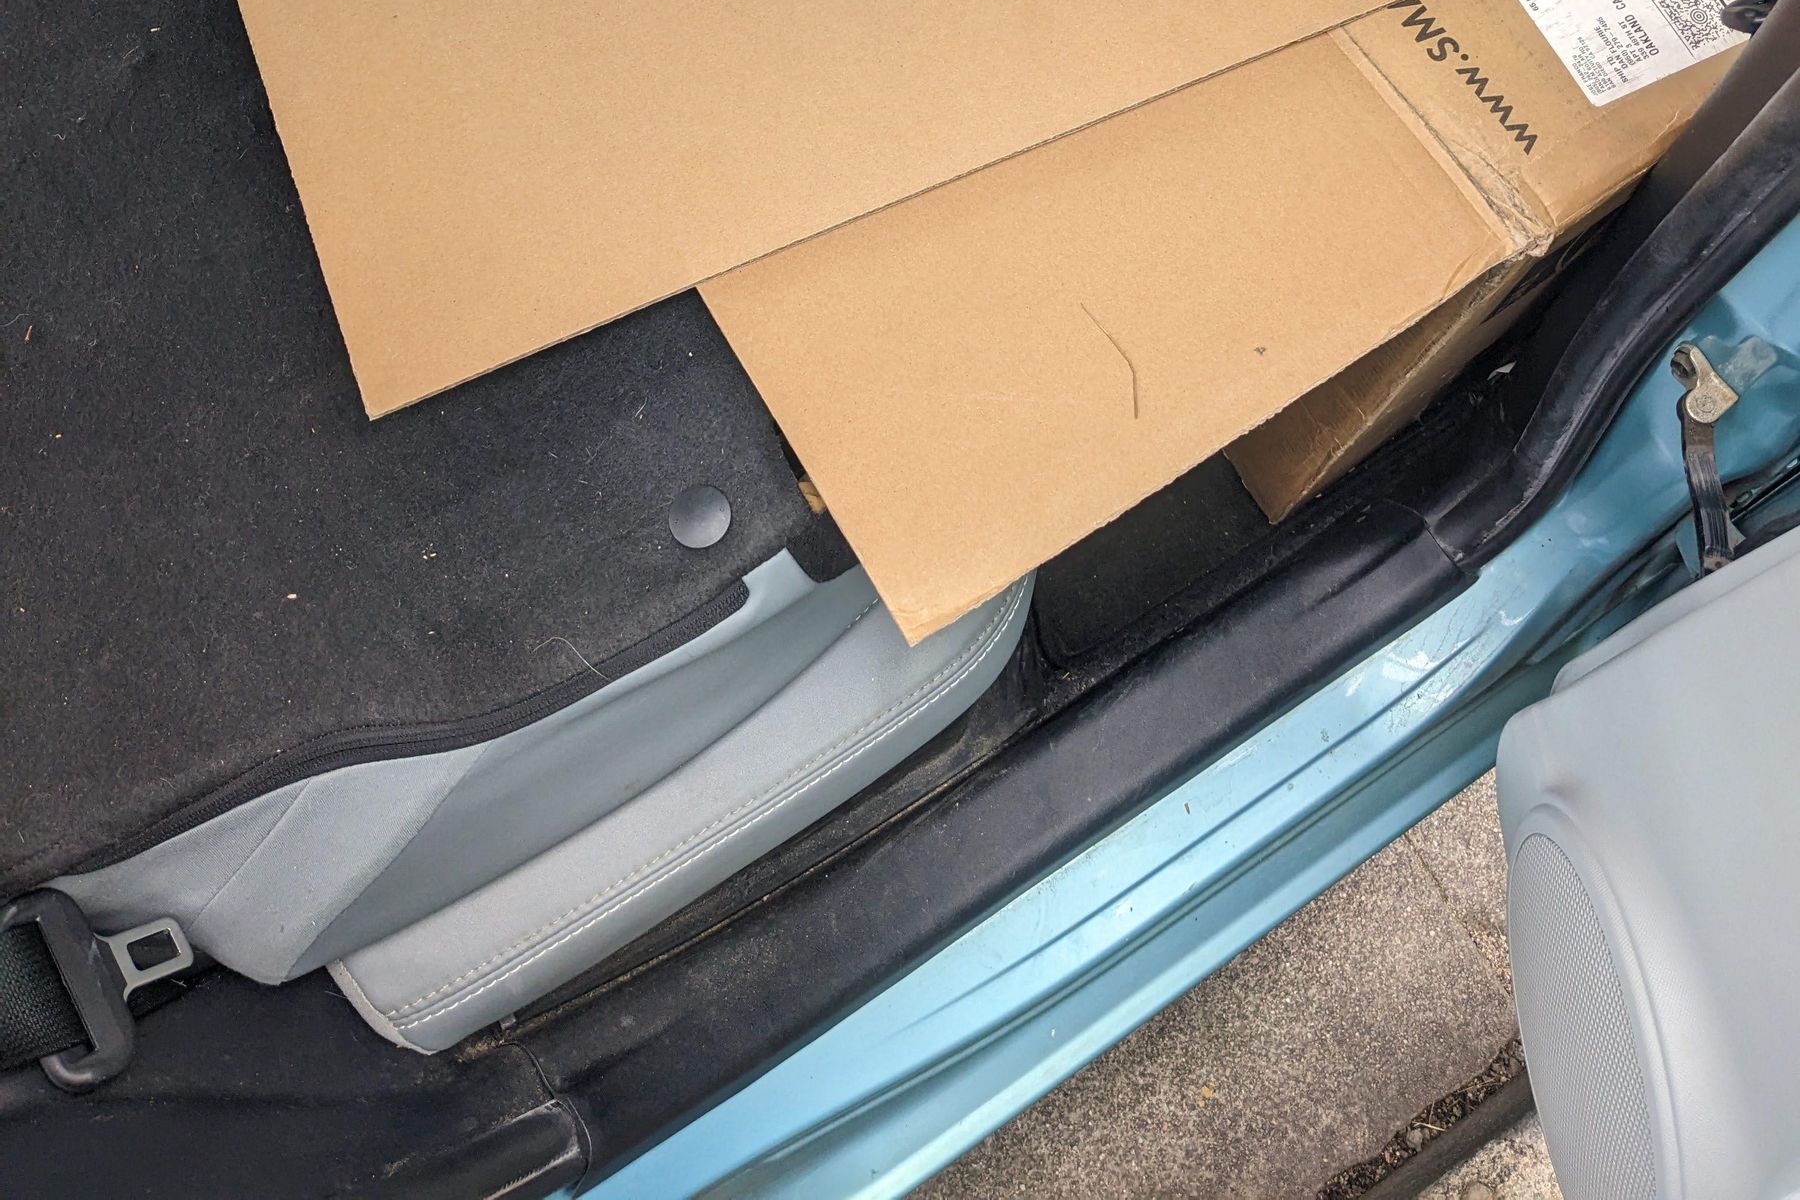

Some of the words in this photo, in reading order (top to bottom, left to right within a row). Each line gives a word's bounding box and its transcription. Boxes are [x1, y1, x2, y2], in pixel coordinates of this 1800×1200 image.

[1617, 20, 1628, 29] ST
[1625, 13, 1659, 56] OAKLAND
[1614, 54, 1628, 68] DAN
[1629, 48, 1643, 62] APT
[1612, 66, 1629, 82] SHIP
